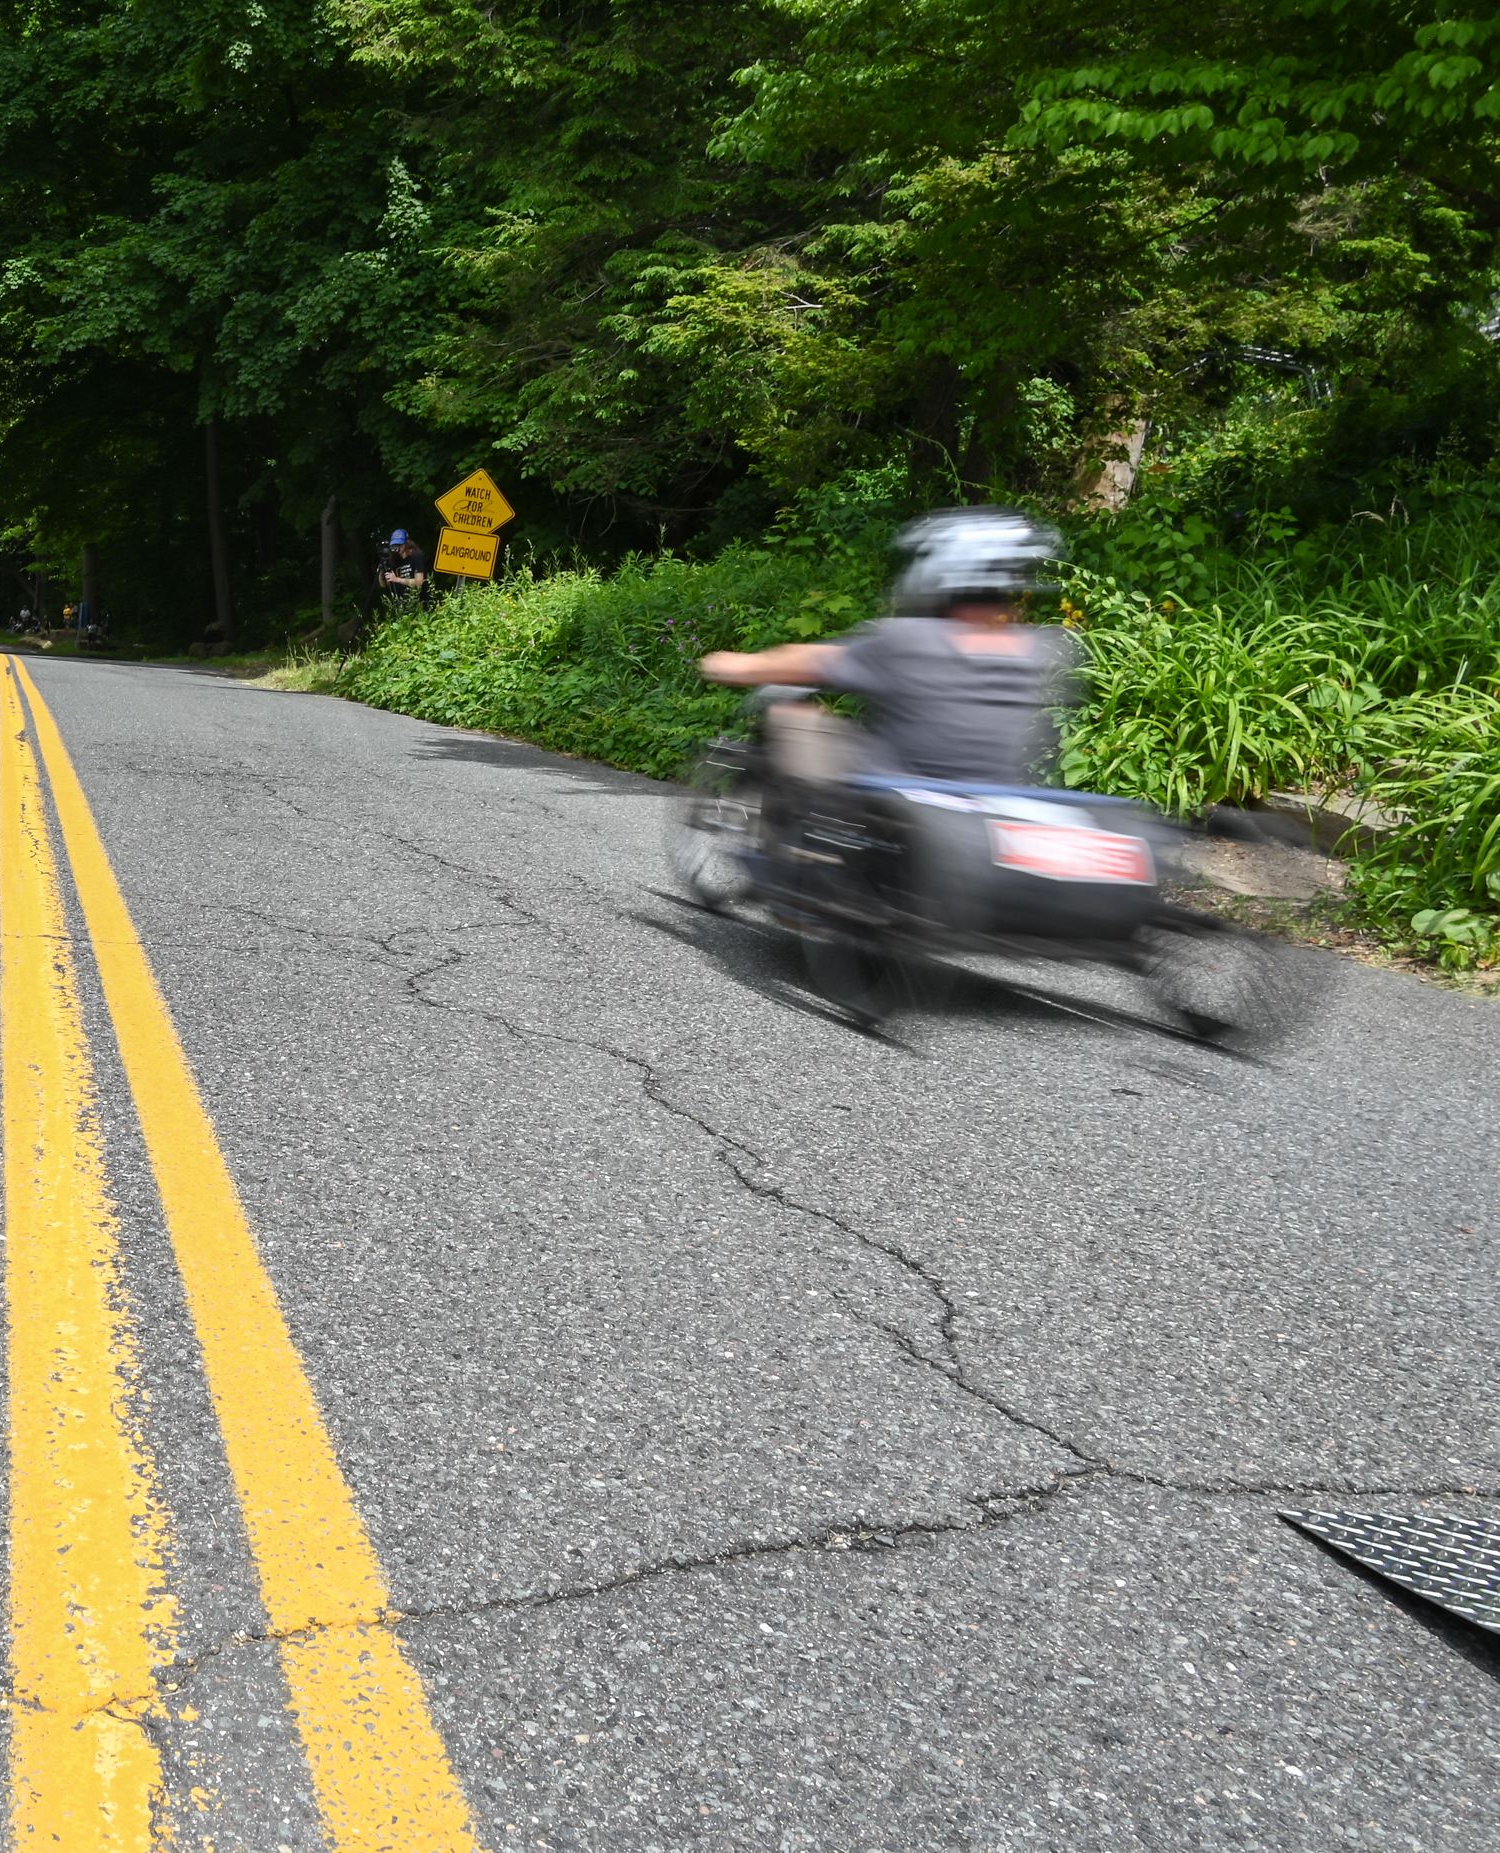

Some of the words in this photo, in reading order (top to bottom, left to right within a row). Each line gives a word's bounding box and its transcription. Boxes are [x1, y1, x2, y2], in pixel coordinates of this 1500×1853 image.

[465, 486, 491, 500] WATCH
[467, 501, 483, 513] FOR
[453, 512, 492, 527] CHILDREN
[441, 544, 491, 562] PLAYGROUND
